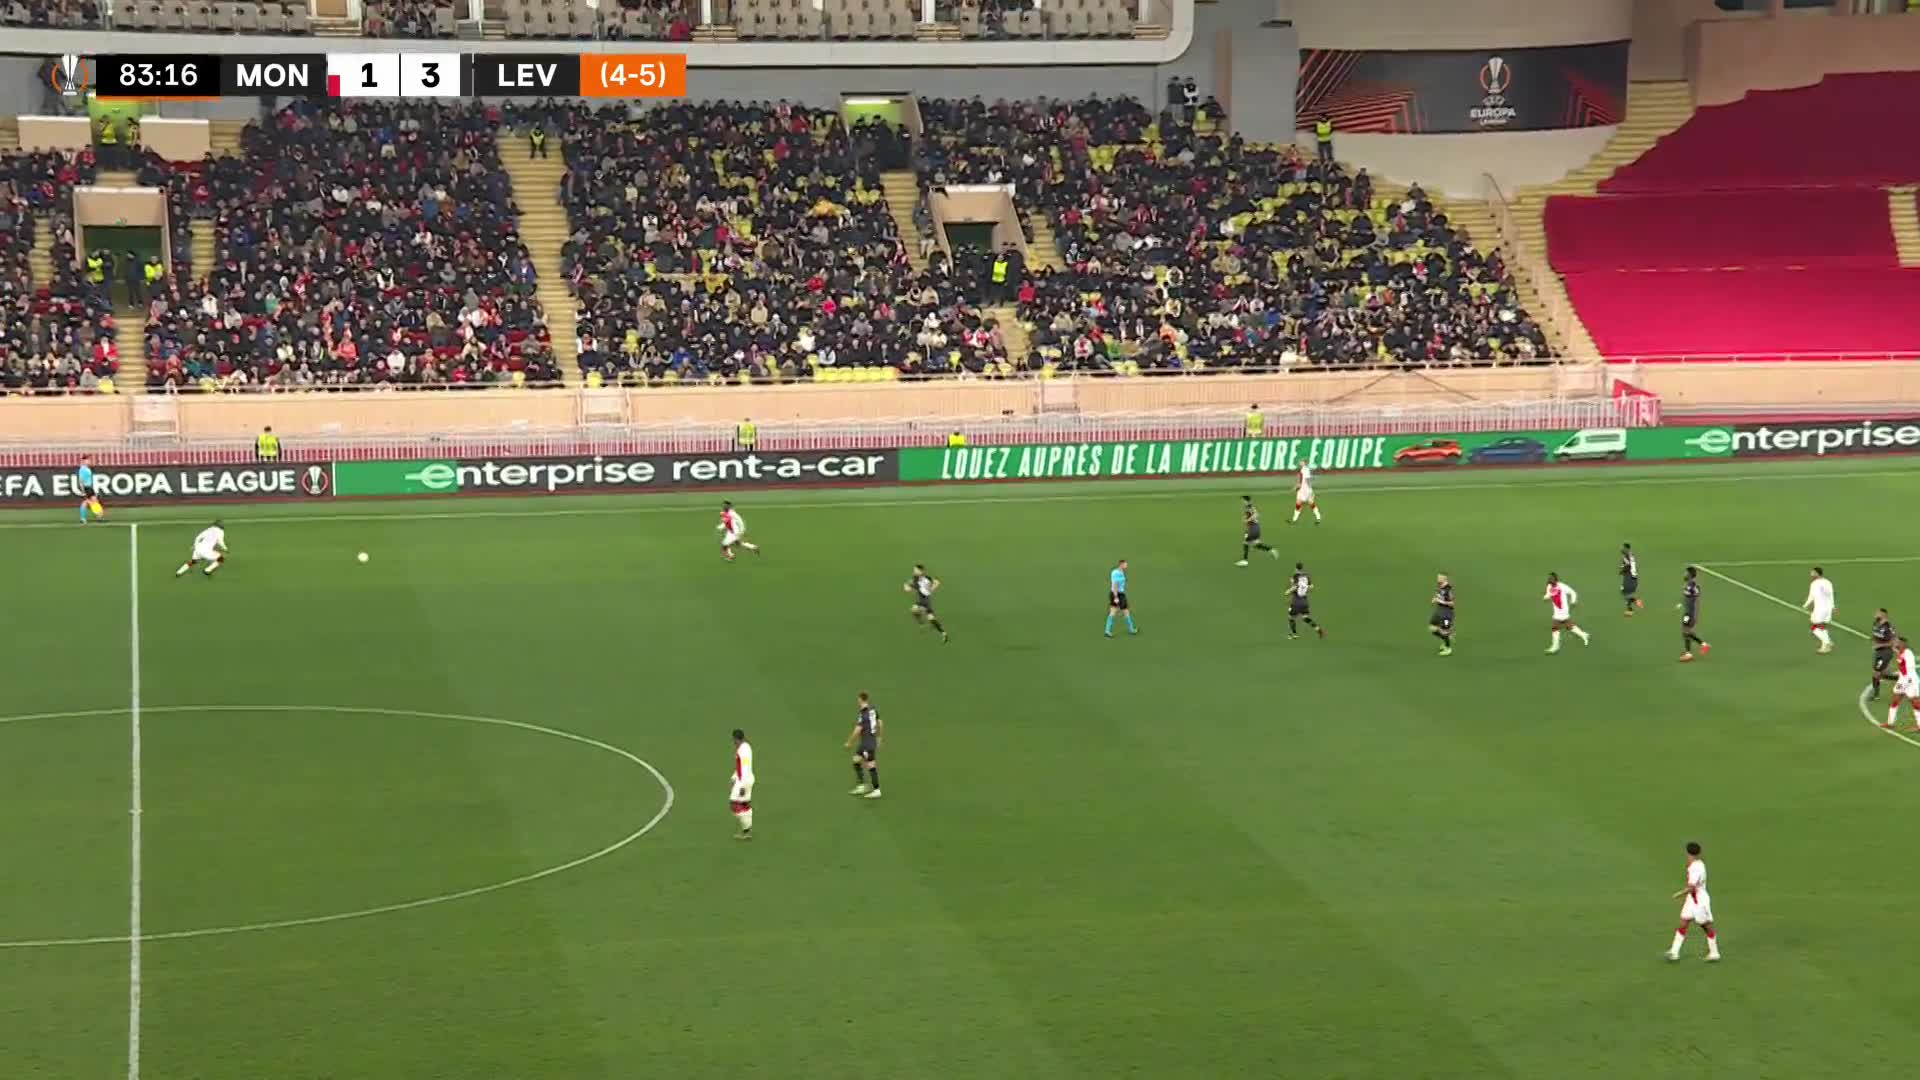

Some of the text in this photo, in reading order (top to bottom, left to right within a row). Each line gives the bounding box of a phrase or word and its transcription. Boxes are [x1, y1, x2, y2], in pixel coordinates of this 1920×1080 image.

[1685, 421, 1920, 454] enterprise
[405, 452, 885, 491] enterprise rent-a-car
[941, 447, 1010, 480] LOUEZ
[1111, 443, 1138, 475] DE
[1146, 442, 1171, 474] LA
[1181, 439, 1301, 473] MEILLEURE
[181, 469, 296, 494] LEAGUE
